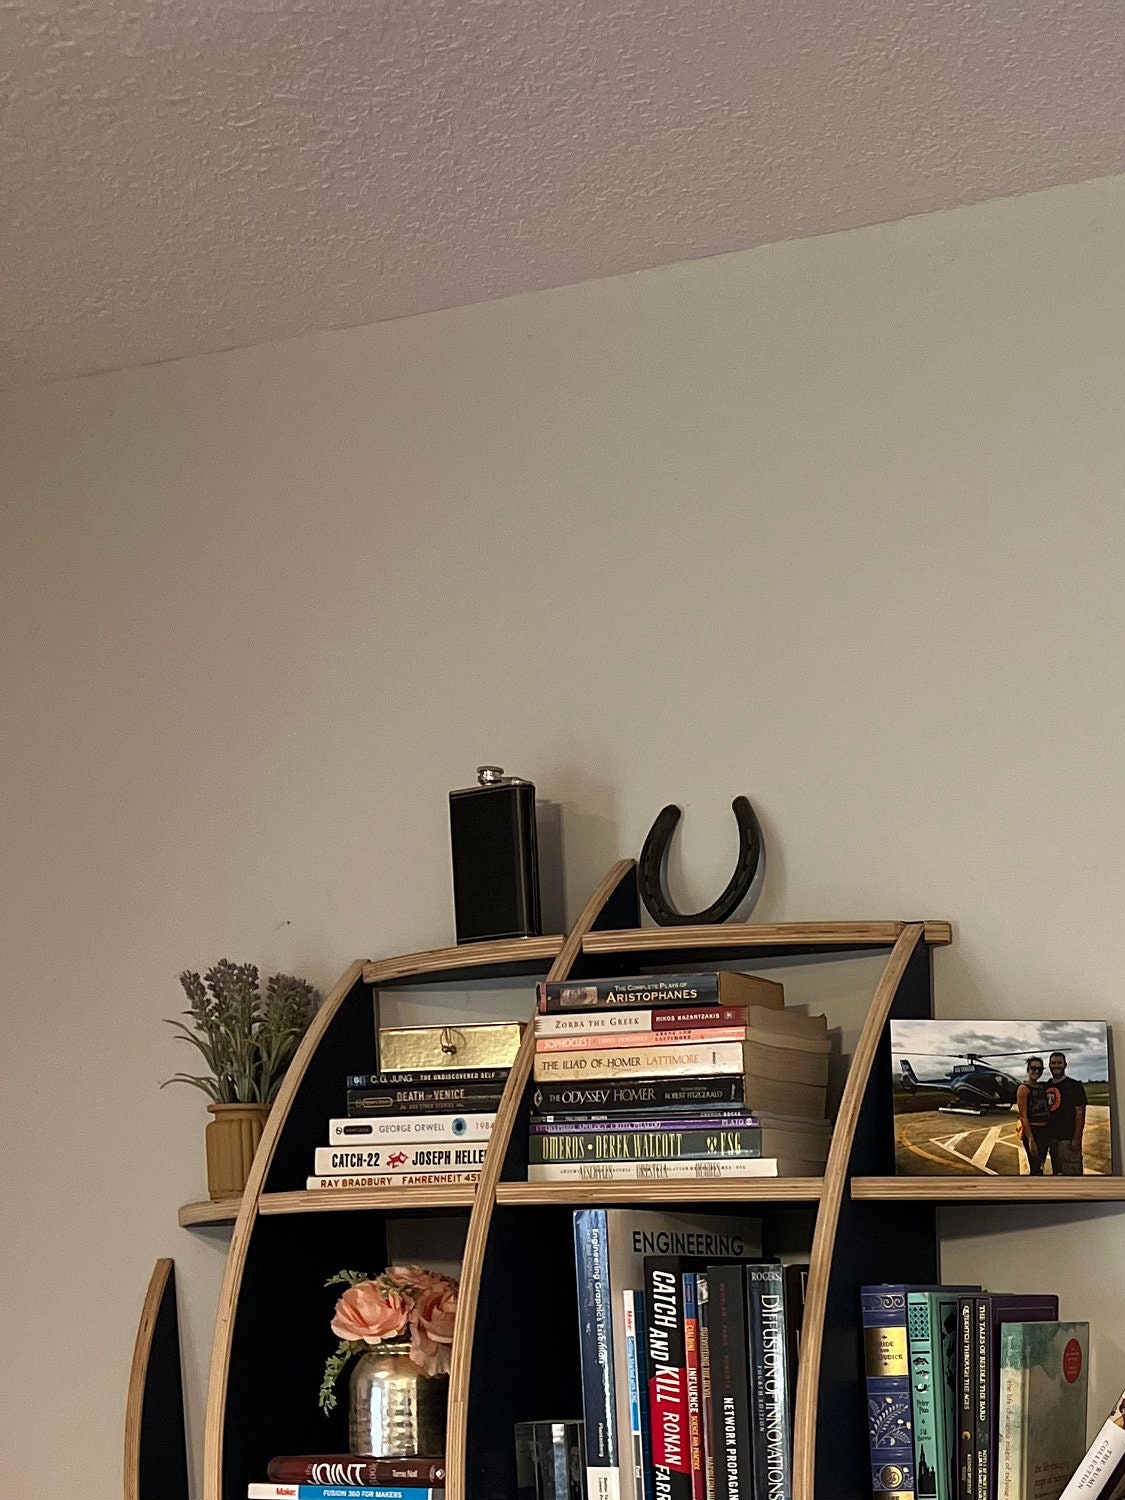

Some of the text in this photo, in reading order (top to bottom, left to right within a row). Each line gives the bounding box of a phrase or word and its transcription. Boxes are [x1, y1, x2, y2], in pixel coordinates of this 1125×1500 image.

[606, 989, 698, 1003] ARISTOPHANES
[555, 1017, 640, 1029] ZORBA THE GREEK
[677, 1012, 720, 1021] KAZANTZAKIS
[544, 1038, 587, 1049] SOPHOCLES
[543, 1054, 699, 1070] THE ILIAD OF HOMER LATTIMORE
[389, 1074, 413, 1083] JUNG
[433, 1072, 479, 1080] UNDISCOVERED
[480, 1071, 496, 1079] SELF
[397, 1091, 425, 1101] DEATH
[433, 1088, 465, 1100] VENICE
[561, 1090, 611, 1104] ODYSSEY
[613, 1088, 656, 1101] HOMER
[379, 1124, 412, 1133] GEORGE
[414, 1123, 445, 1132] ORWELL
[542, 1133, 682, 1159] OMEROS DEREK WALCOTT
[721, 1132, 741, 1156] FSG
[332, 1153, 380, 1168] CATCH-22
[412, 1150, 487, 1166] JOSEPH HELLE
[320, 1177, 393, 1188] RAY BRADBURY
[402, 1174, 462, 1185] FAHRENHEIT
[632, 1230, 744, 1256] ENGINEERING
[592, 1228, 600, 1280] Engineering
[751, 1271, 781, 1282] ROGERS
[594, 1281, 602, 1322] Graphics
[652, 1270, 678, 1329] CATCH
[649, 1327, 669, 1361] AND
[761, 1294, 781, 1378] DIFFUSION
[979, 1345, 986, 1355] OF
[655, 1364, 681, 1403] KILL
[688, 1367, 698, 1413] INFLUENCE
[723, 1397, 736, 1446] NETWORK
[662, 1411, 682, 1466] RONAN
[1004, 1462, 1012, 1471] of
[1077, 1440, 1109, 1489] COLLECTION
[1086, 1450, 1113, 1488] THE RUMI
[307, 1463, 366, 1486] JOINT
[323, 1489, 347, 1497] FUSION
[375, 1491, 403, 1499] MAKERS
